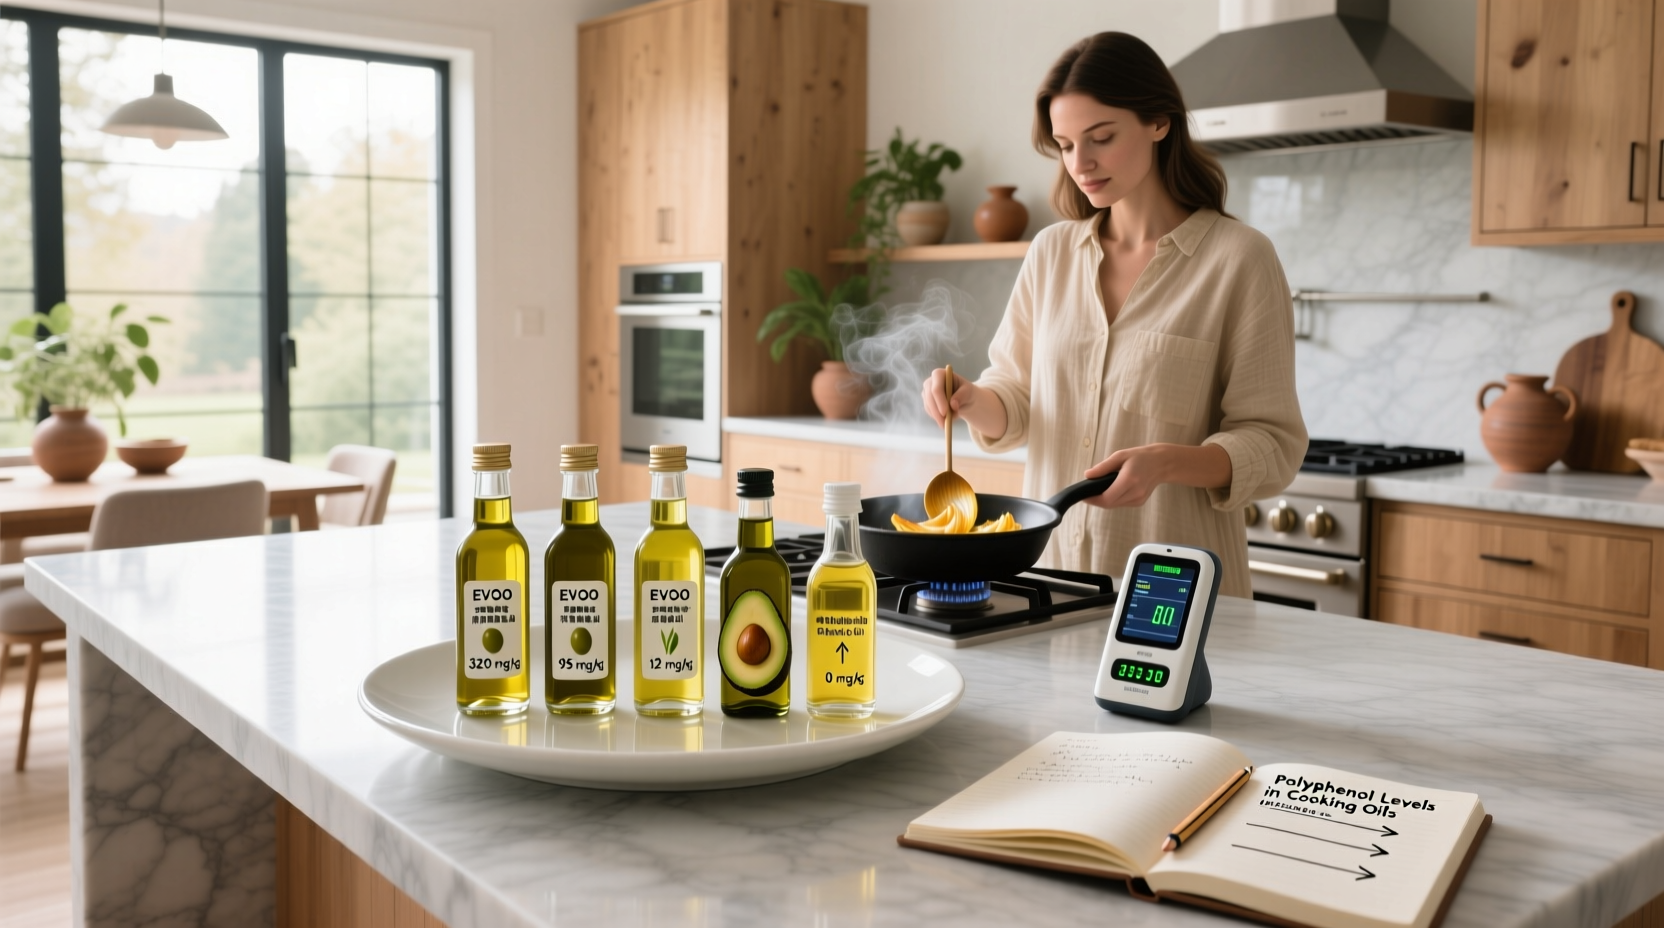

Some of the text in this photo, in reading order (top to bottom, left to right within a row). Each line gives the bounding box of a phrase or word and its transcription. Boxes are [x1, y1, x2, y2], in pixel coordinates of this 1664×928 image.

[472, 588, 513, 601] EVOO
[559, 588, 599, 601] EVOO
[650, 588, 690, 601] EVOO
[468, 657, 492, 670] 320
[558, 657, 574, 670] 95
[649, 657, 662, 670] 12
[825, 671, 833, 684] 0
[1273, 774, 1436, 812] Polyphenol Levels
[1263, 786, 1281, 799] in
[1286, 789, 1358, 815] Cooking
